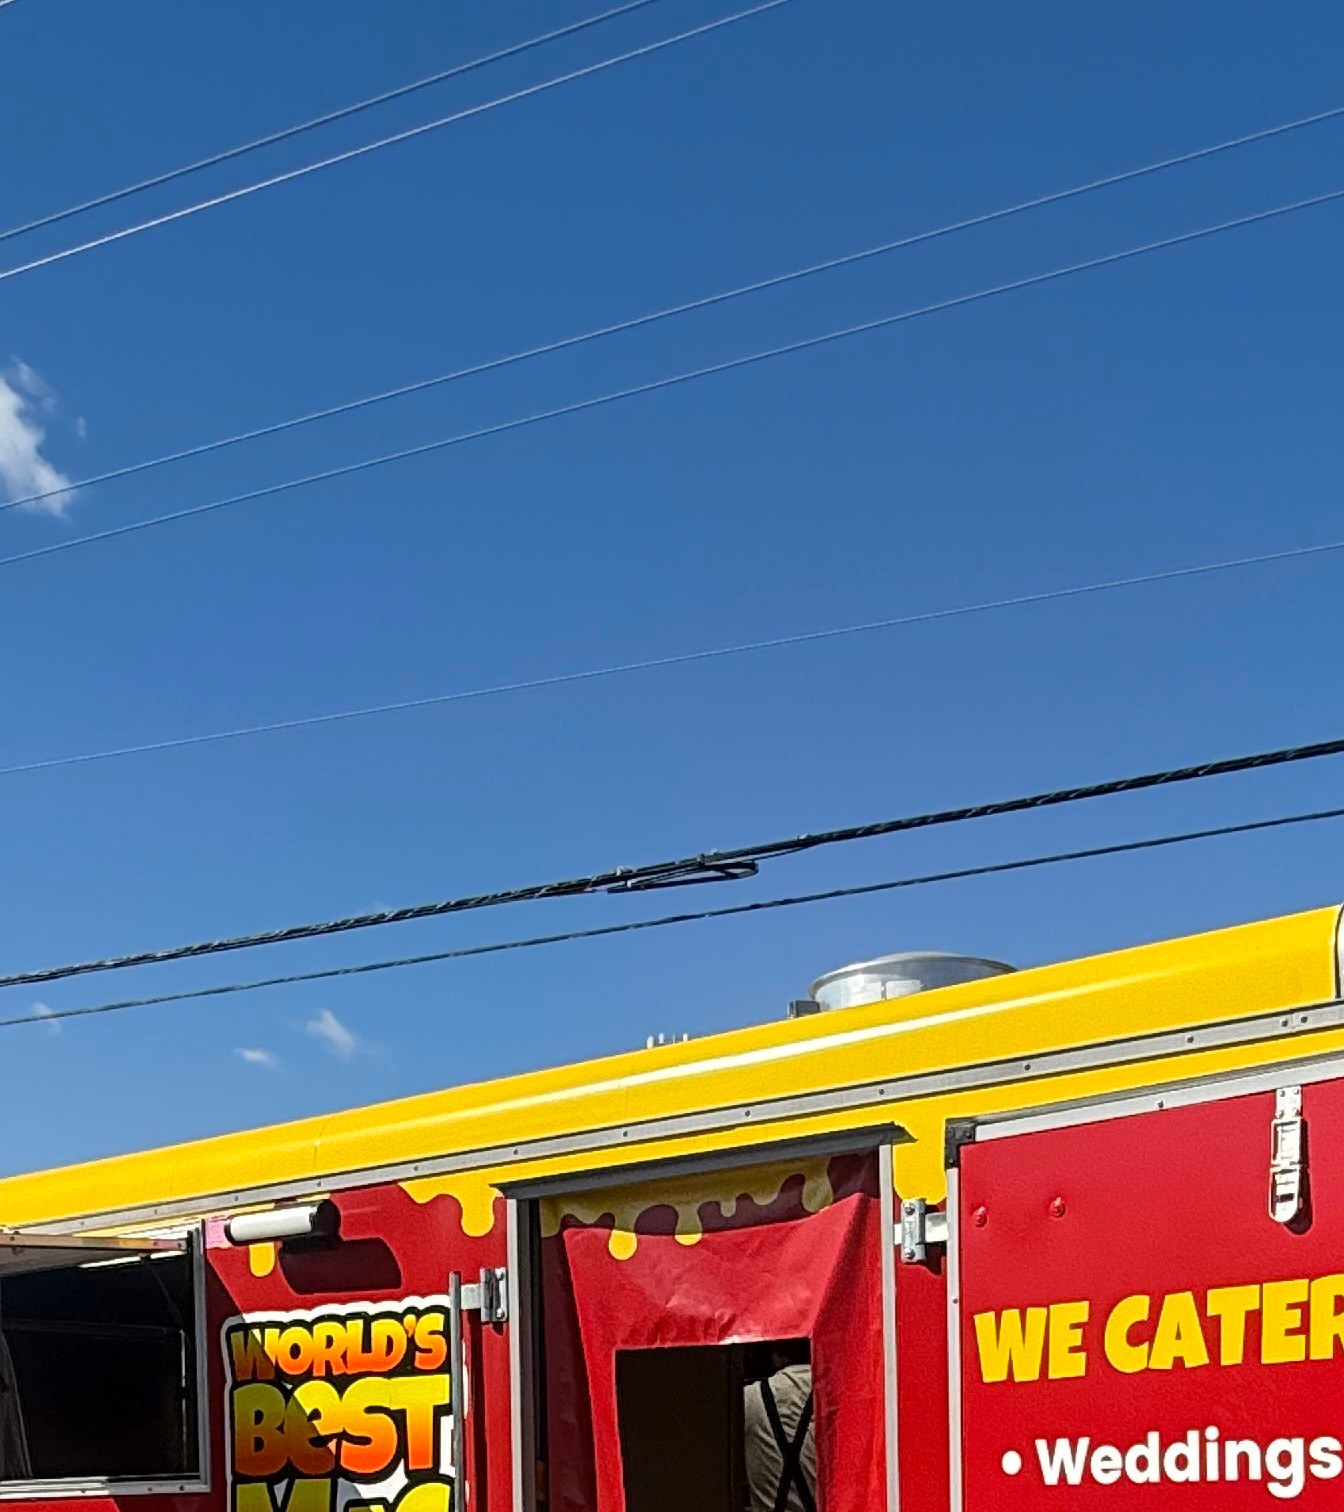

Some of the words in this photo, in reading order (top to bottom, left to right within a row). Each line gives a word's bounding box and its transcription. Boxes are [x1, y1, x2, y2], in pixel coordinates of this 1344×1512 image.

[230, 1312, 447, 1382] WORLD'S
[973, 1301, 1089, 1384] WE
[1034, 1425, 1343, 1499] Weddings
